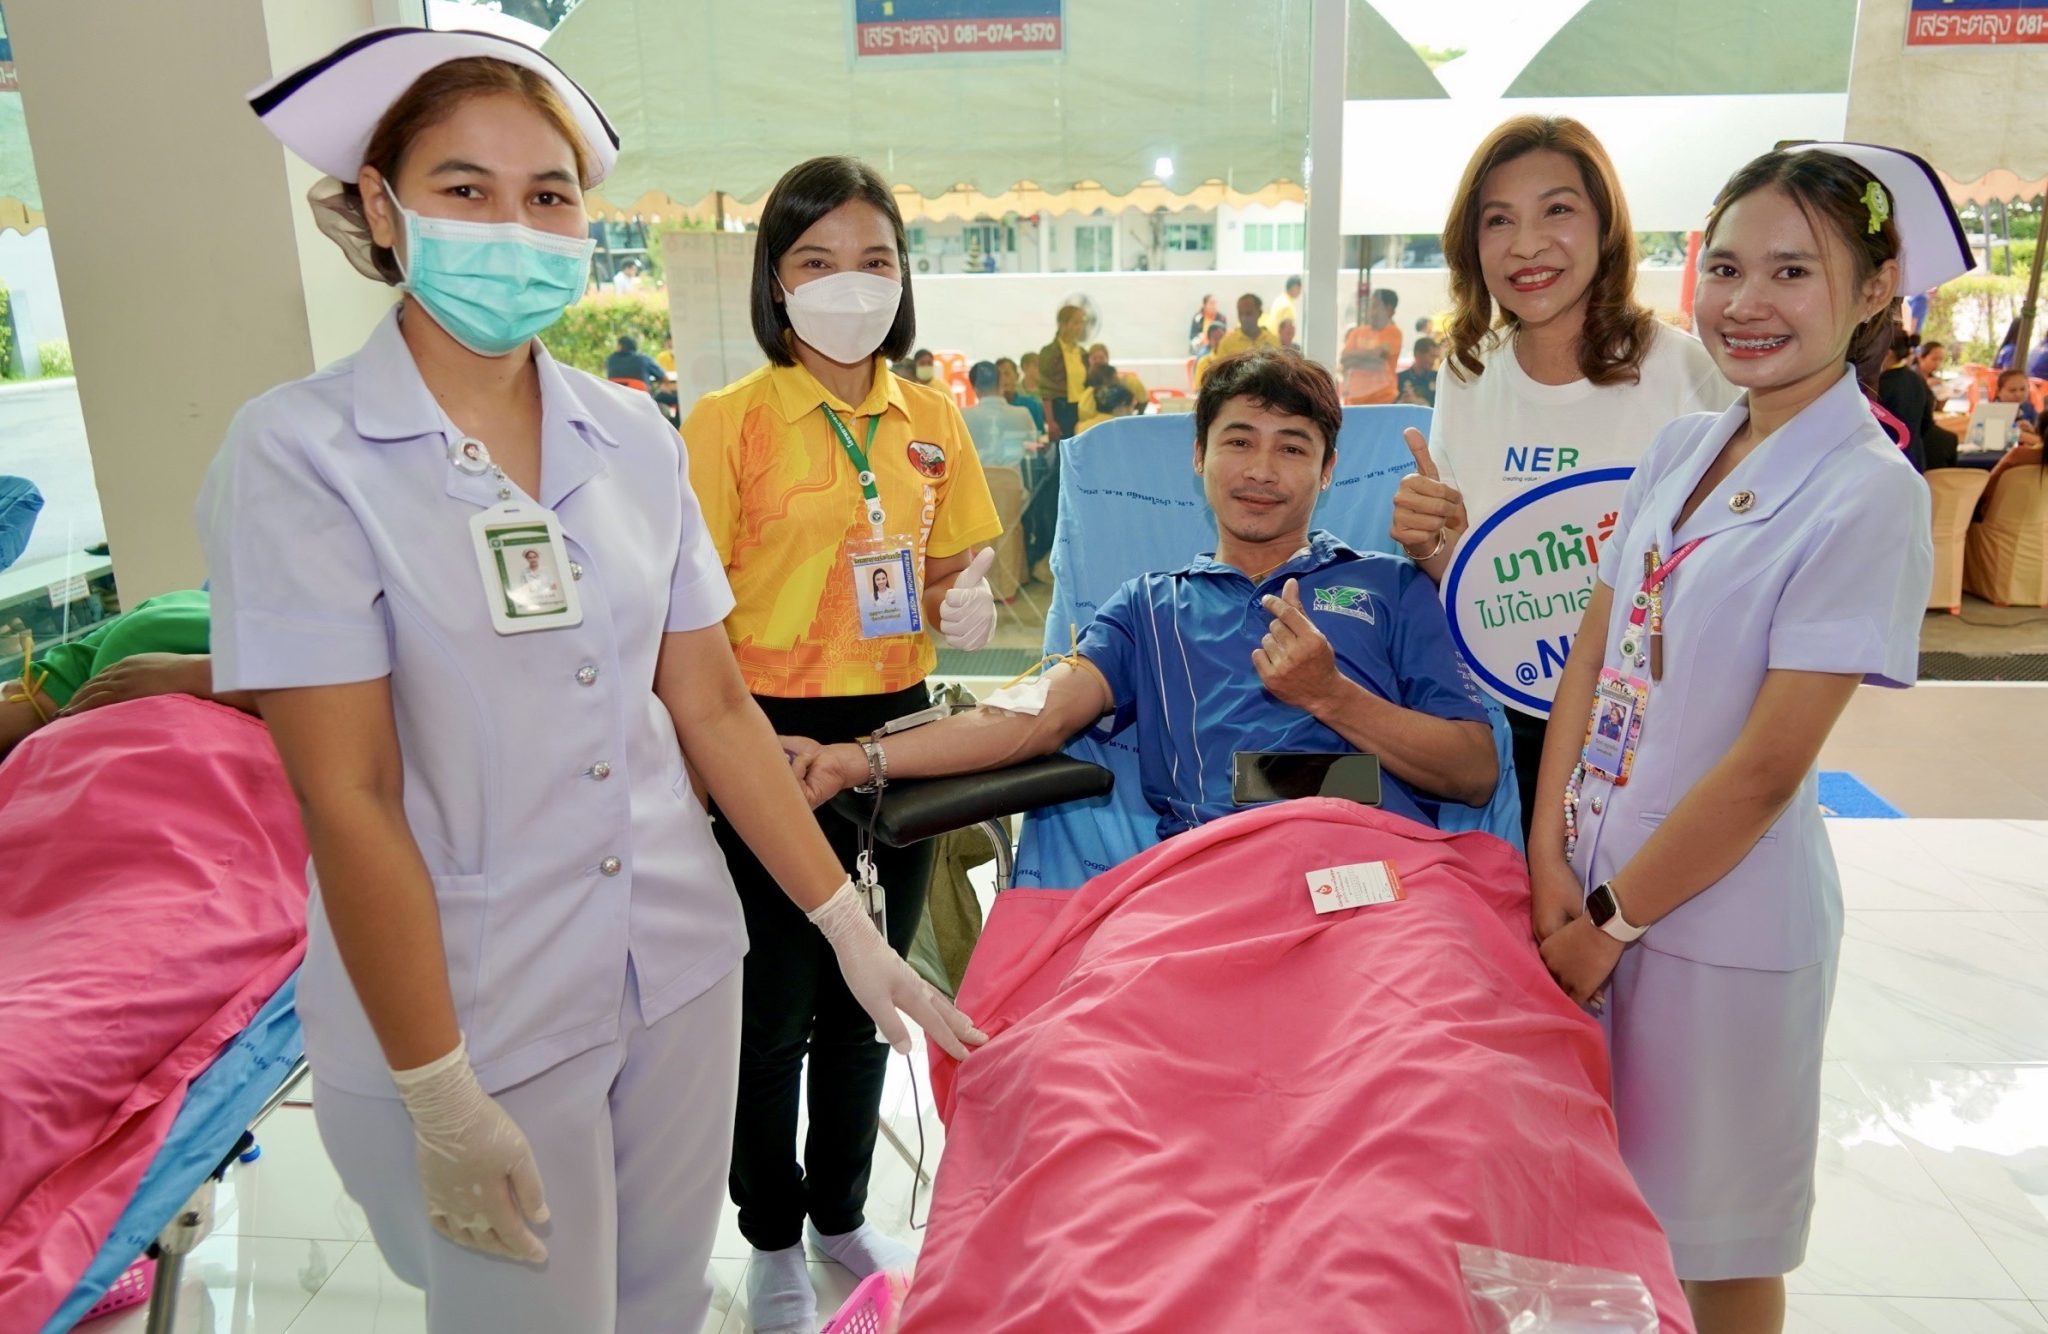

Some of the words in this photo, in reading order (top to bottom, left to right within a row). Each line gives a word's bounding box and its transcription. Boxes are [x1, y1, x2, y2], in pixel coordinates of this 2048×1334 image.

[954, 23, 1055, 44] 081-074-3570
[1504, 447, 1579, 472] NER
[1516, 635, 1573, 686] @N
